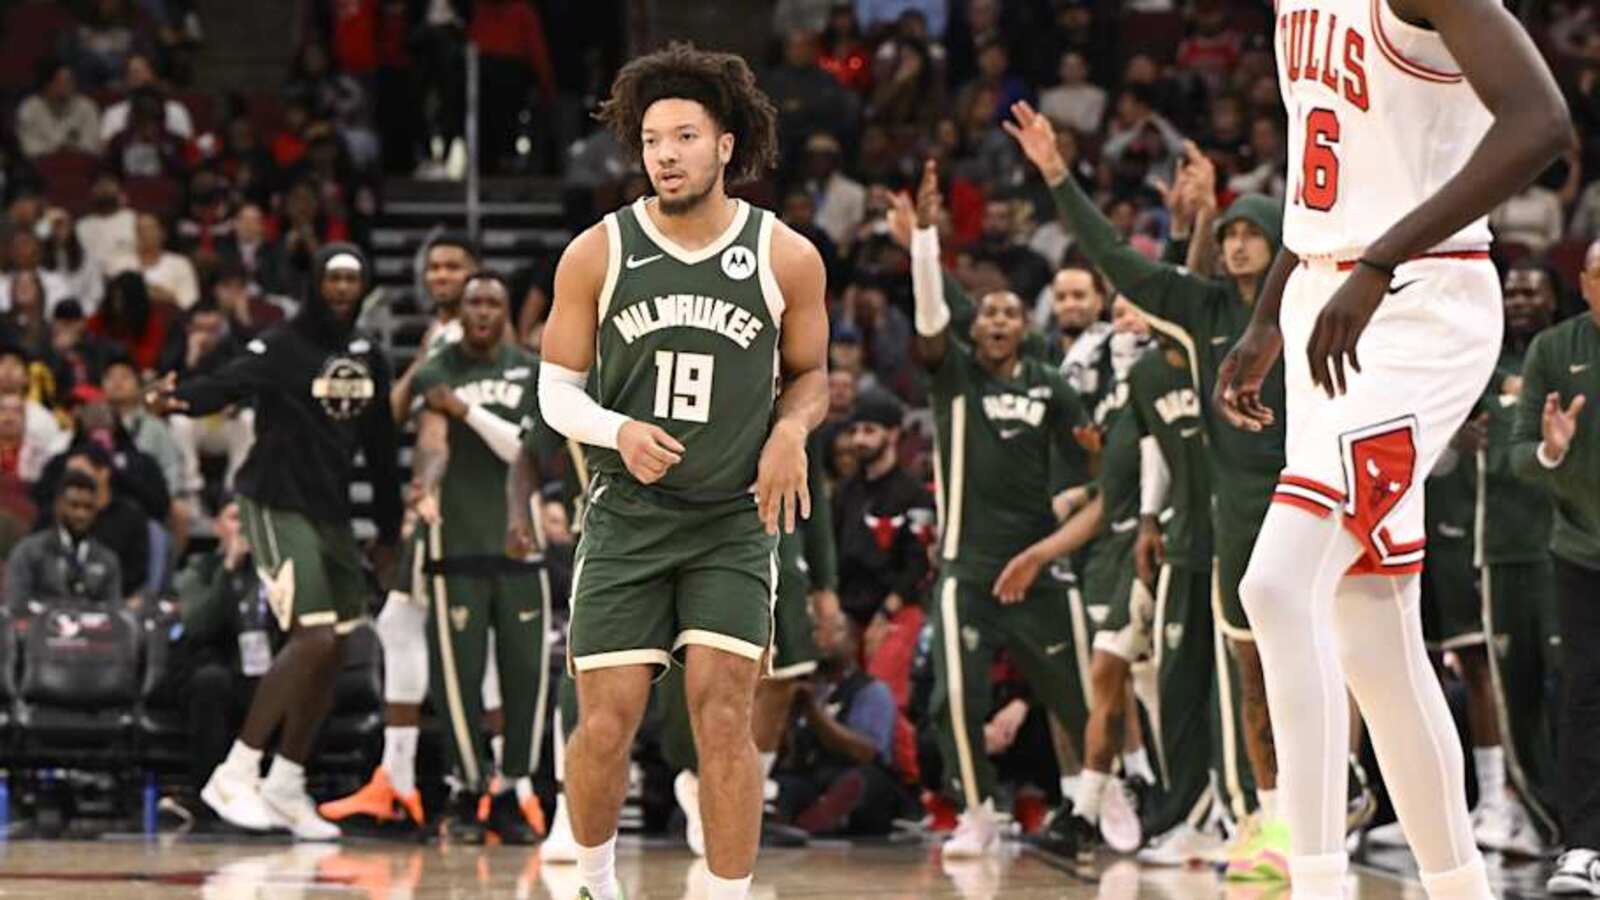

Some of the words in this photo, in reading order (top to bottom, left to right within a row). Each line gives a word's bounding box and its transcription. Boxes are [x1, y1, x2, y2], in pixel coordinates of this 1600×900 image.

[1281, 9, 1369, 112] ULLS
[612, 294, 764, 349] MILWAUKEE
[653, 350, 715, 423] 19
